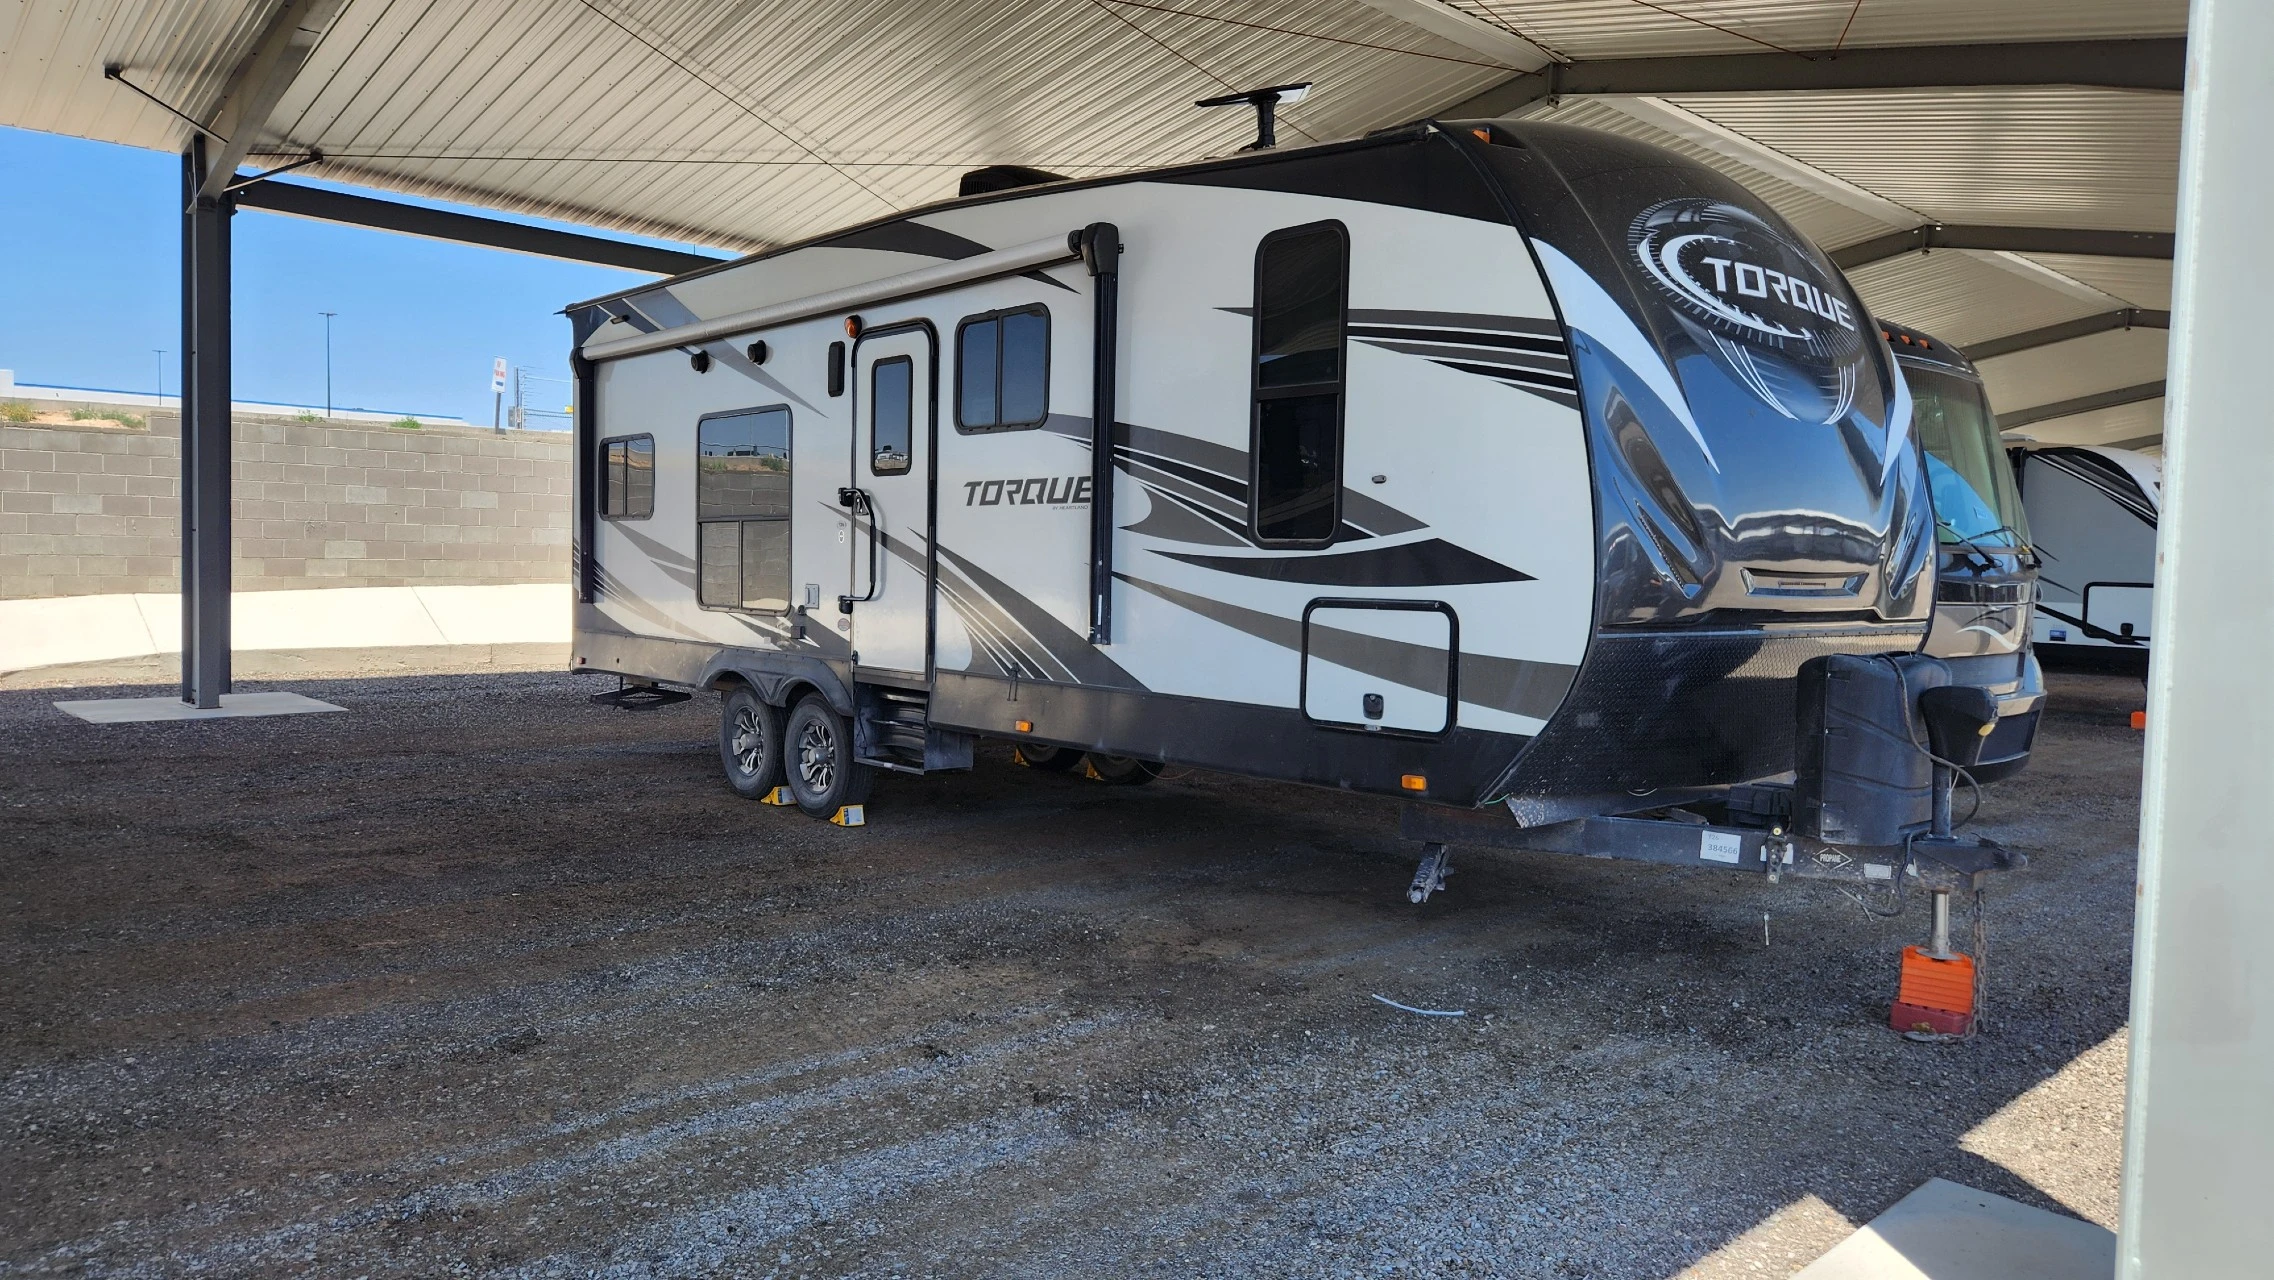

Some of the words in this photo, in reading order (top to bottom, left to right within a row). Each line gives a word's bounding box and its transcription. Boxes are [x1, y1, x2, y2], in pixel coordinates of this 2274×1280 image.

[1700, 256, 1855, 331] TORQUE
[963, 476, 1091, 506] TORQUE
[1707, 843, 1738, 855] 384566
[1819, 853, 1842, 863] PROPANE
